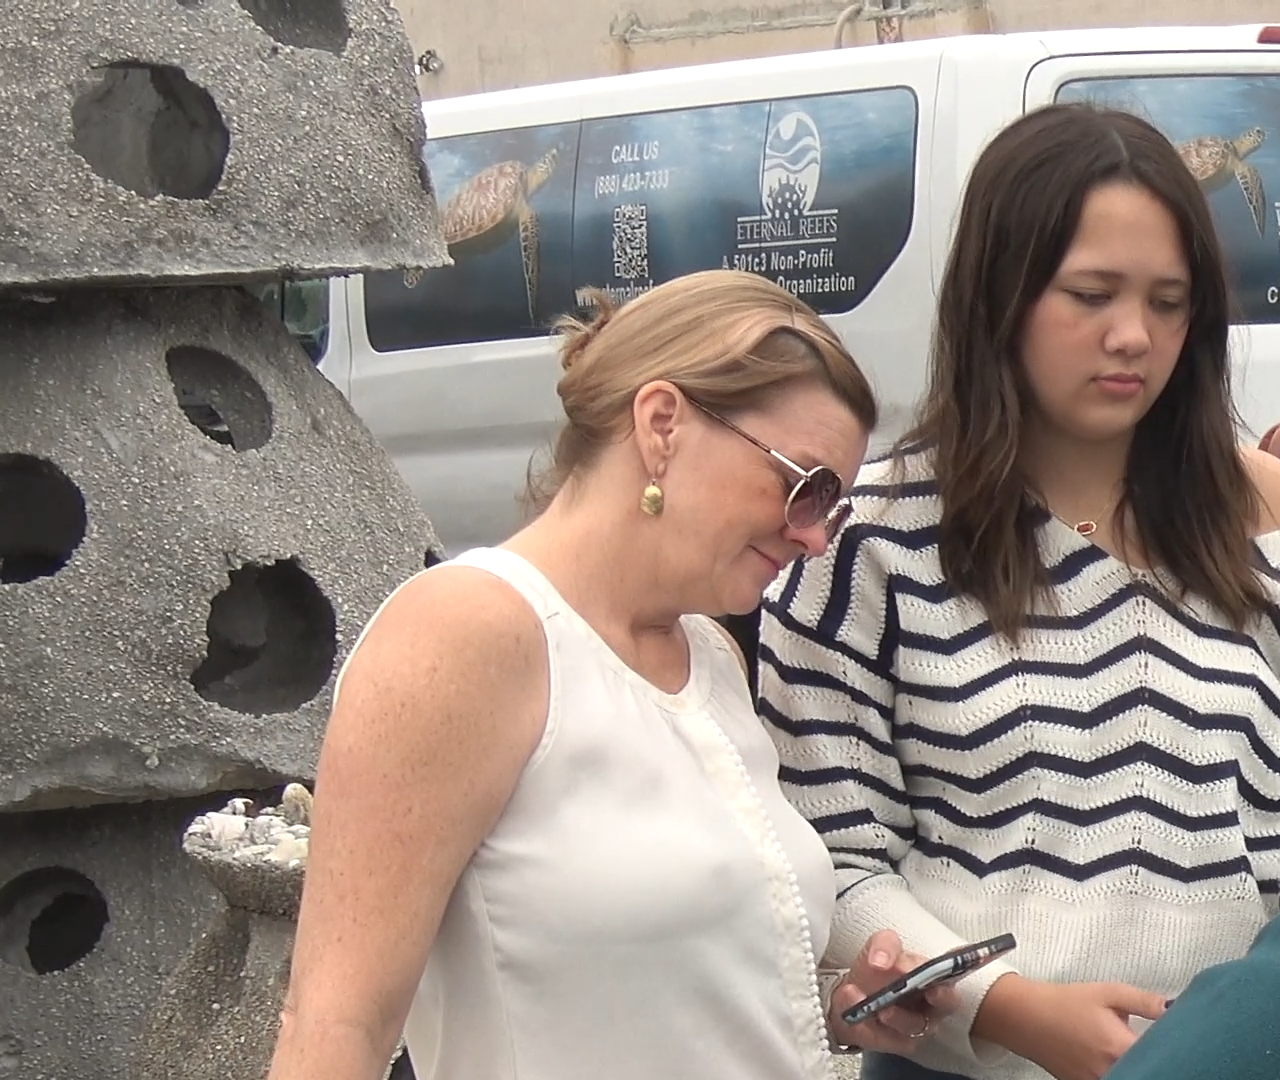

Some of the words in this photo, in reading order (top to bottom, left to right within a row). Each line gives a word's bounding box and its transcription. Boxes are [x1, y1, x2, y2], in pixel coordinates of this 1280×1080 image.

[612, 143, 640, 164] CALL
[643, 140, 659, 160] US
[594, 173, 620, 199] (888)
[622, 170, 669, 192] 423-7333
[737, 219, 794, 241] ETERNAL
[799, 216, 838, 239] REEFS
[722, 255, 730, 270] A
[733, 252, 767, 272] 501c3
[770, 248, 834, 271] Non-Profit
[776, 272, 856, 297] Organization
